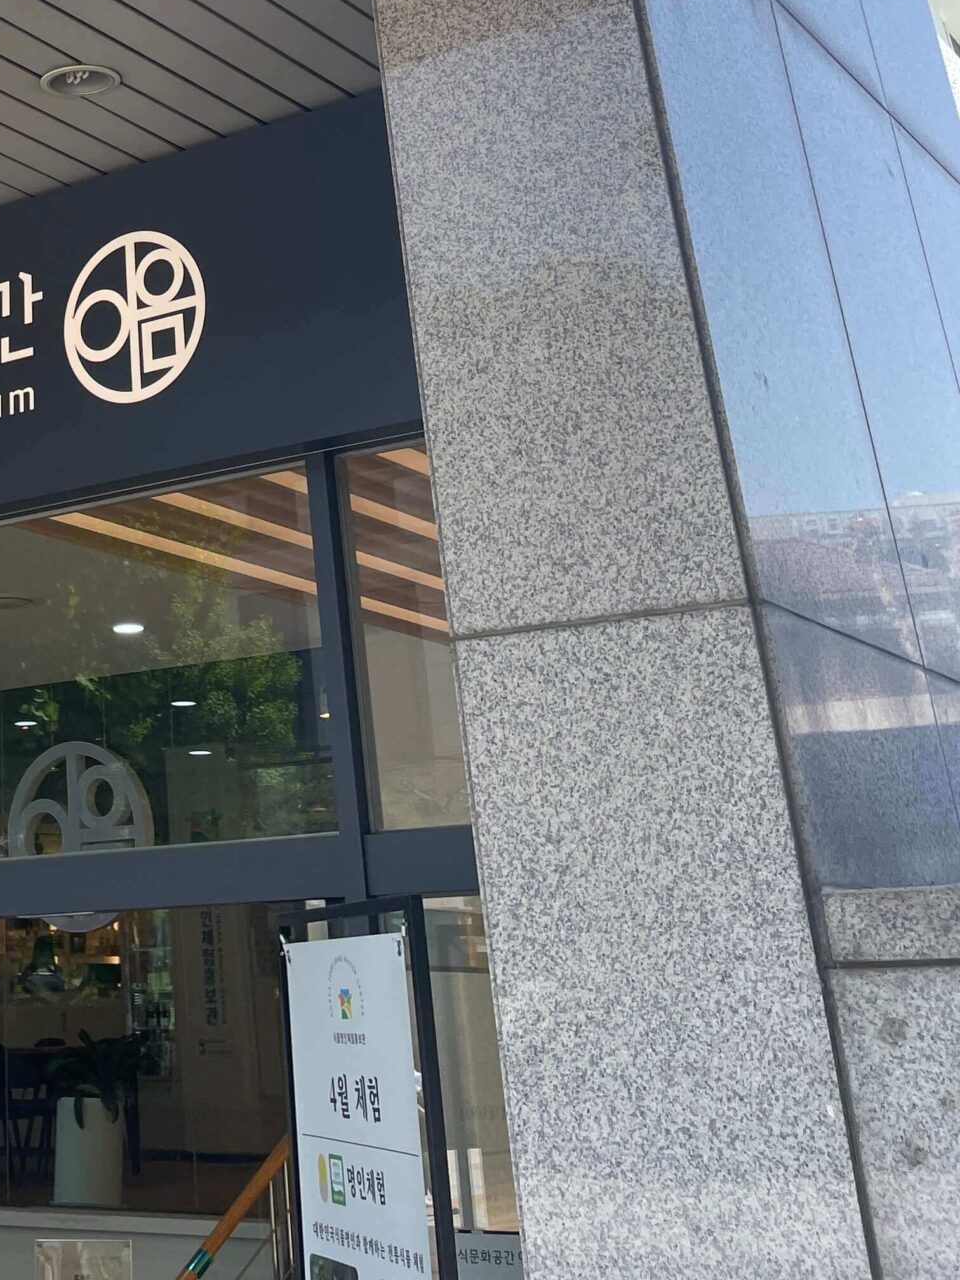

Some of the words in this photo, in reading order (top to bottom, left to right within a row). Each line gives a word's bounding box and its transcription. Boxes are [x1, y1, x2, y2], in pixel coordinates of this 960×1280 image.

[329, 1073, 351, 1119] 4월
[354, 1075, 381, 1123] 체험
[346, 1165, 386, 1205] 명인체험
